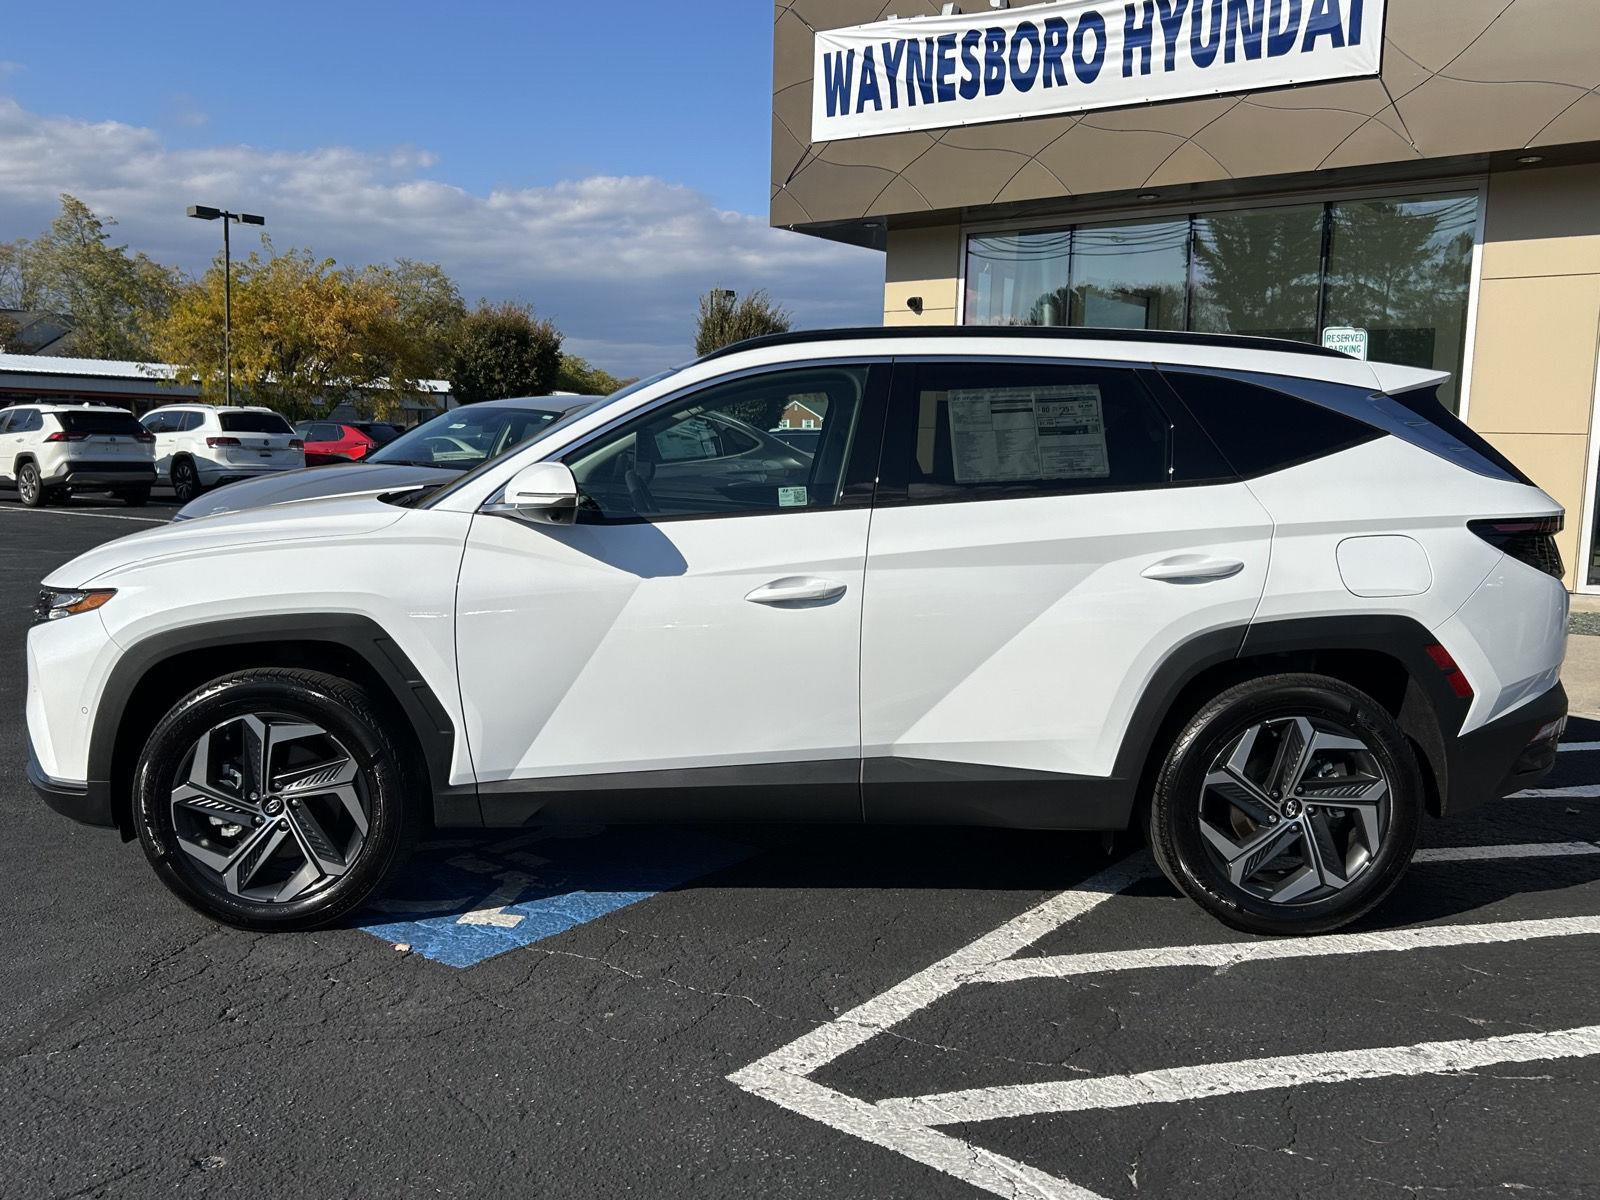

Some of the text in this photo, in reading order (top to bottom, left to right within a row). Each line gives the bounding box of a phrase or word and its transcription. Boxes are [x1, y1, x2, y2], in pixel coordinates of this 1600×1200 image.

[823, 0, 1362, 117] WAYNESBORO HYUNDAI
[1327, 334, 1364, 342] RESERVED
